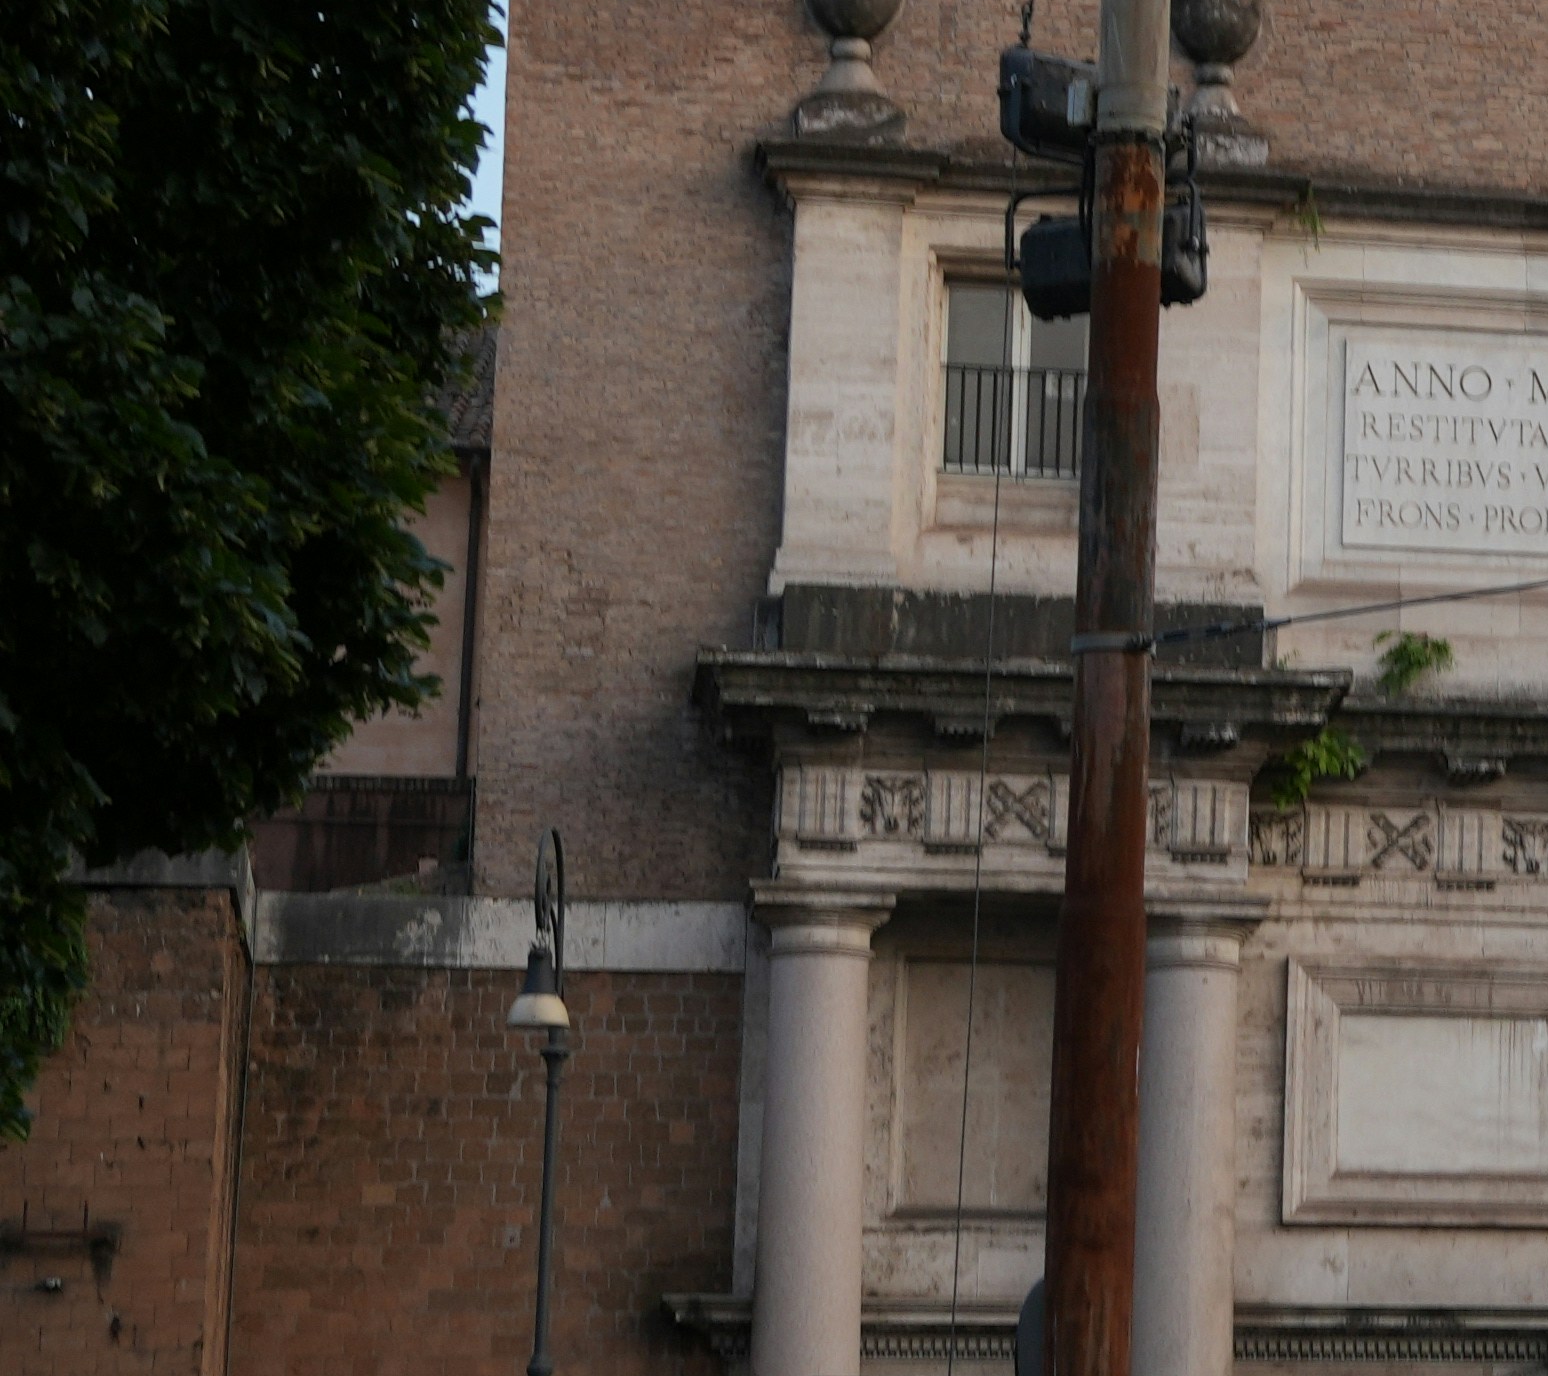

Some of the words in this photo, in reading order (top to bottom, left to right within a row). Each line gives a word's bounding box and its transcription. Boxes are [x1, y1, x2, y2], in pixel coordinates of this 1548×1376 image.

[1351, 361, 1491, 404] ANNO
[1346, 452, 1512, 491] TVRRIBVS
[1355, 499, 1461, 533] FRONS
